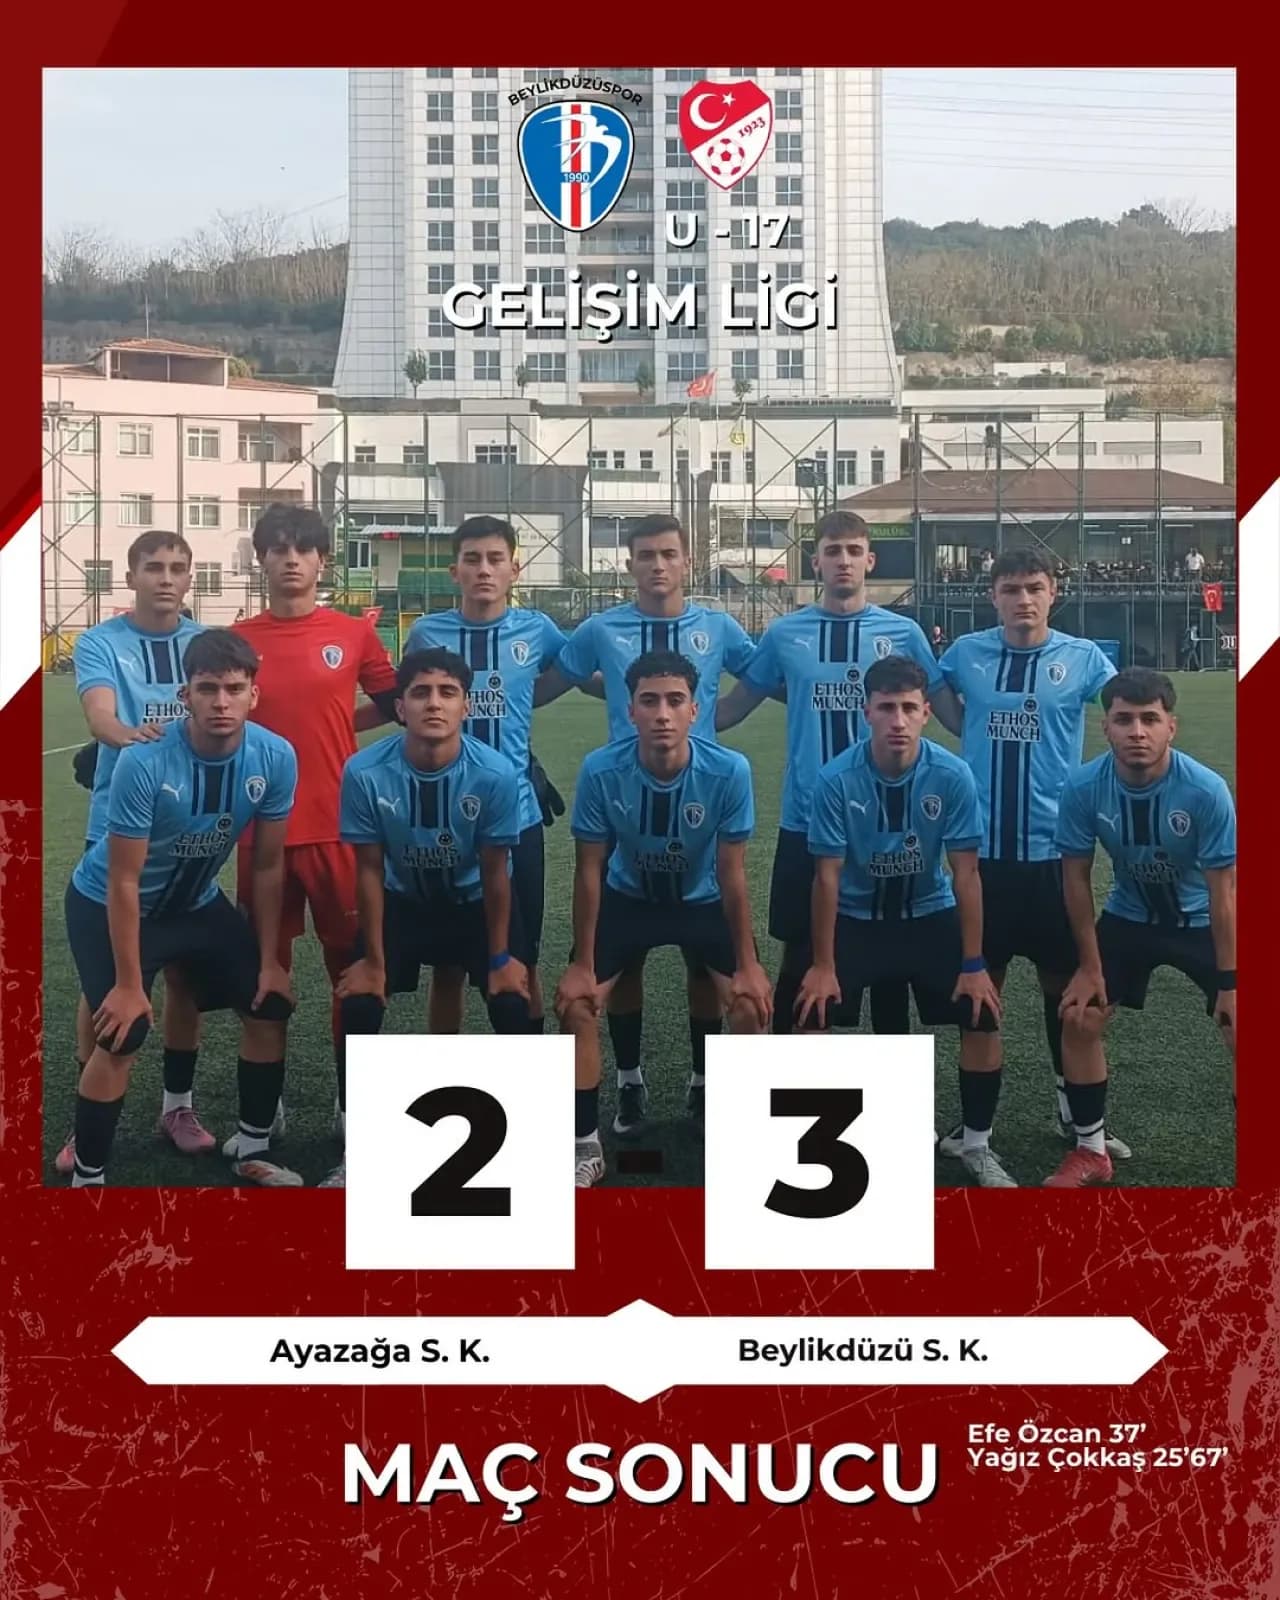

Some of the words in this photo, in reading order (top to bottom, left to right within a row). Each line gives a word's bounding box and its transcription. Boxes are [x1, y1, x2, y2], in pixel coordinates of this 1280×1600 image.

[467, 690, 505, 704] THOS
[815, 682, 863, 697] ETHOS
[812, 696, 865, 710] MUNCH
[990, 711, 1039, 727] ETHOS
[986, 724, 1040, 741] MUNCH
[872, 847, 920, 864] ETHOS
[869, 858, 925, 876] MUNCH
